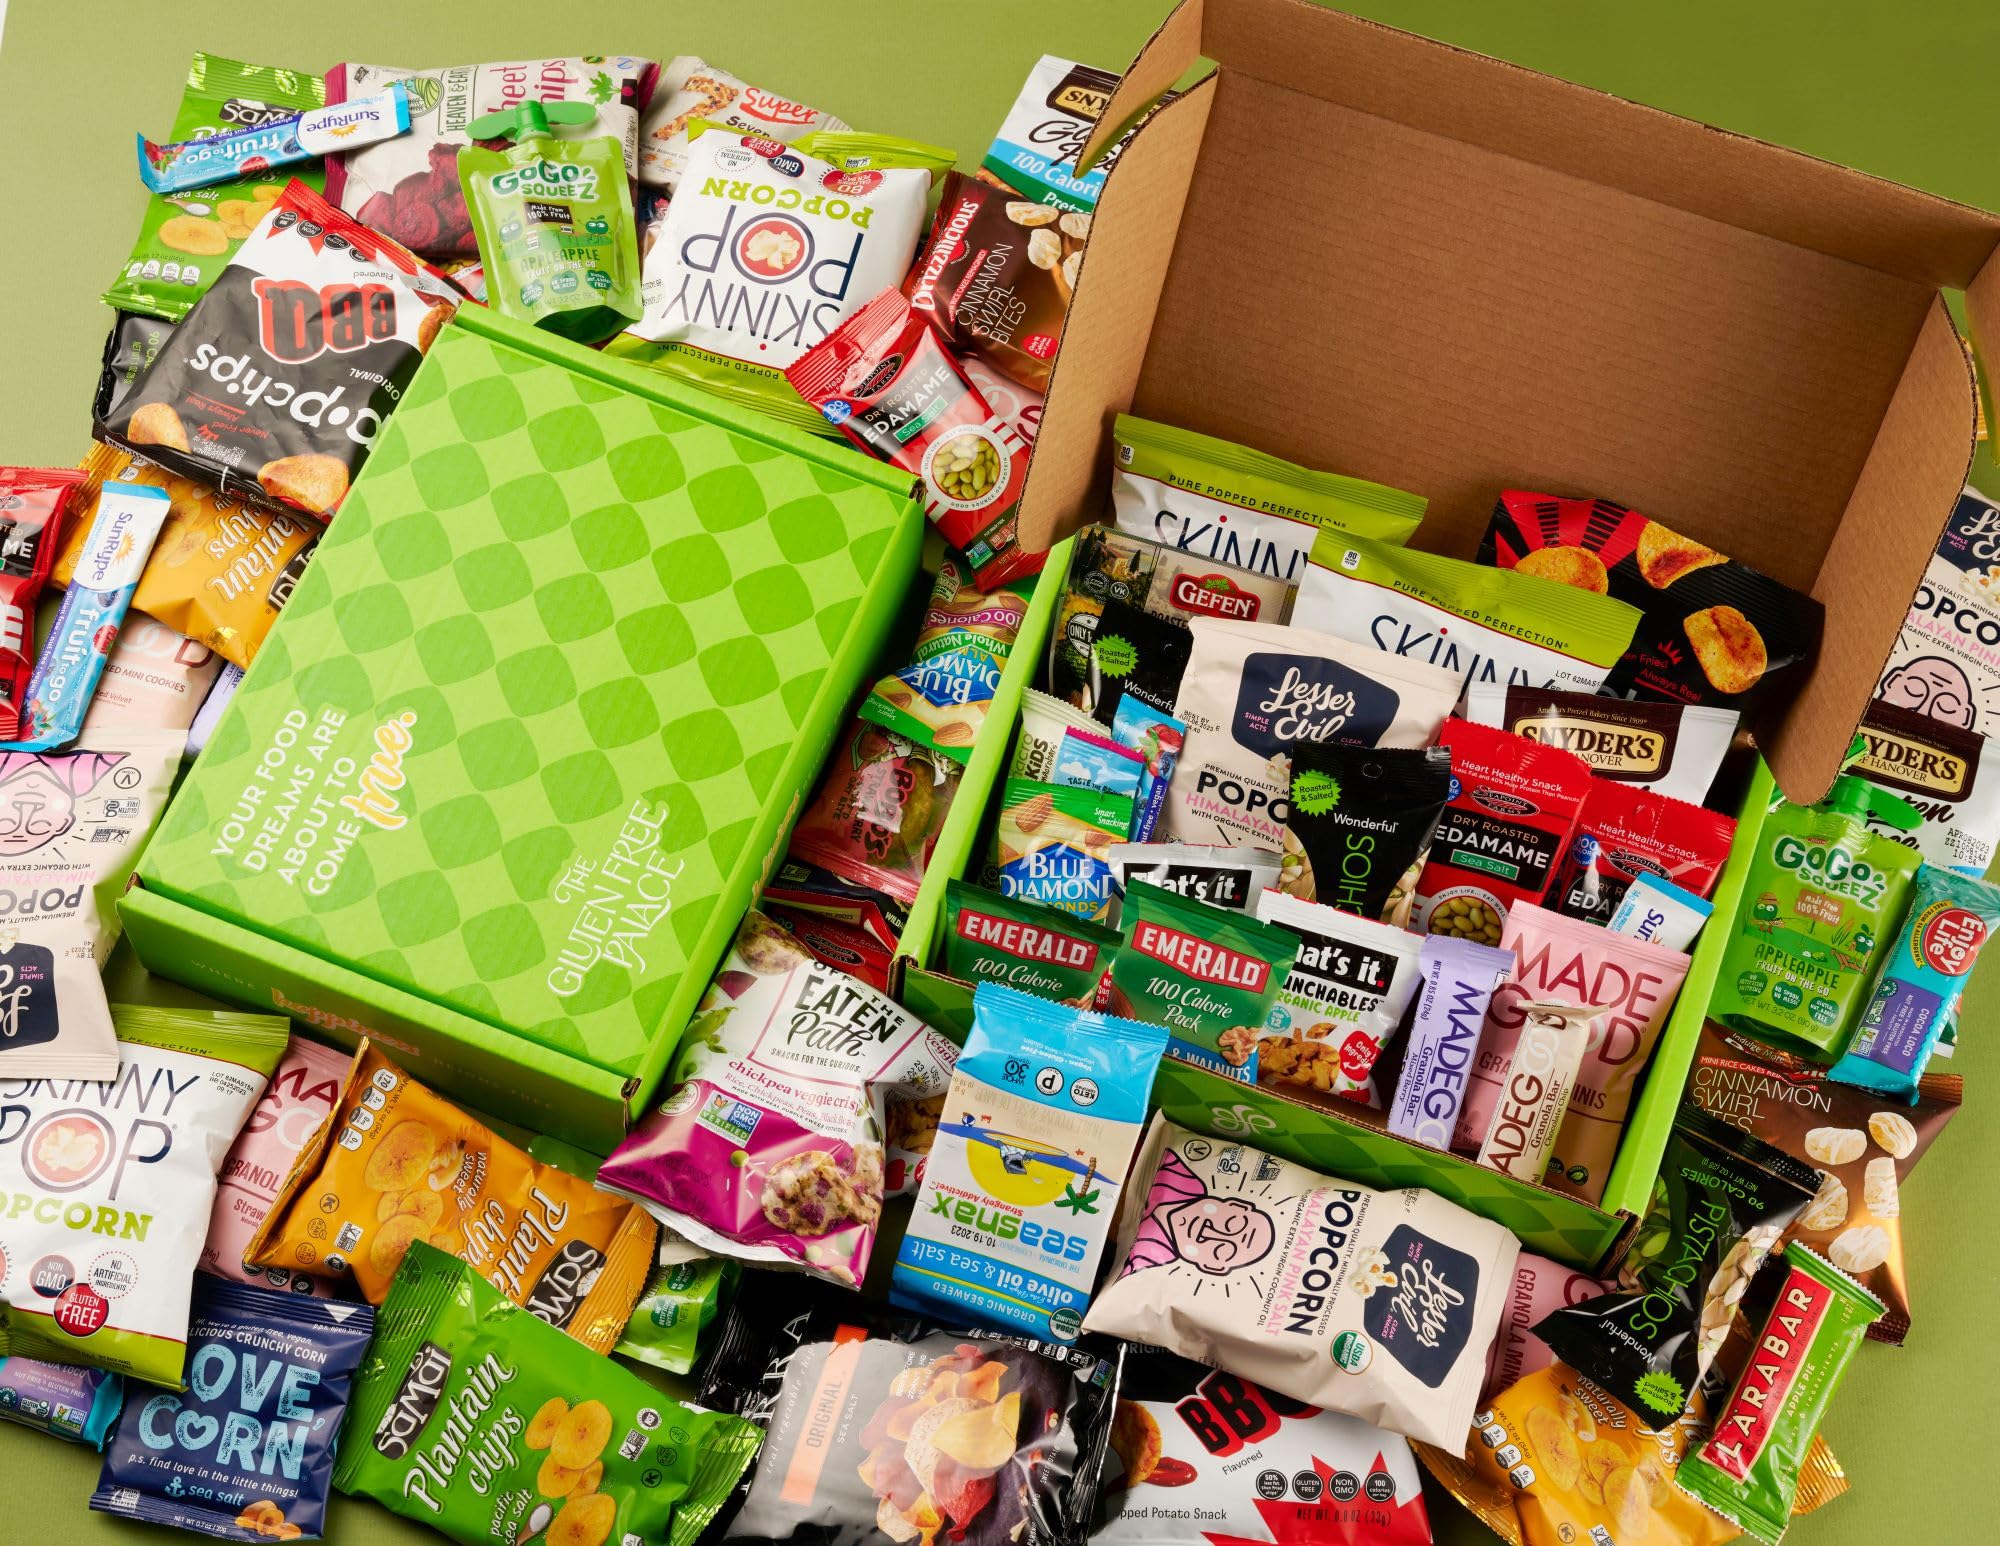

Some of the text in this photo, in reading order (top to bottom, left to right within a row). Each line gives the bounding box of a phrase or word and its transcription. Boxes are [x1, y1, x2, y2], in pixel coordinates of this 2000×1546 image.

[307, 111, 380, 132] SunRype
[446, 91, 466, 132] HEAVEN
[743, 87, 819, 121] Super
[185, 148, 211, 165] go
[227, 133, 280, 161] fruit
[1011, 152, 1101, 197] 100 Calori
[700, 177, 874, 229] POPCORN
[681, 204, 864, 301] POP
[353, 271, 394, 280] Flavored
[956, 243, 1014, 326] CINNAMON
[972, 285, 1014, 335] SWIRL
[990, 296, 1026, 344] BITES
[734, 363, 780, 380] POPPED
[862, 366, 951, 444] EDAMAME
[865, 369, 928, 422] DRY ROASTED
[1169, 474, 1201, 491] PURE
[1207, 486, 1256, 507] POPPED
[92, 512, 132, 580] SunRype
[1178, 581, 1250, 618] GEFEN
[63, 608, 96, 666] fruit
[930, 610, 1020, 628] 100 Calories
[916, 634, 1006, 659] Whole Natural
[49, 674, 66, 702] go
[122, 668, 186, 692] MINI COOKIES
[911, 666, 971, 703] BLUE
[1259, 666, 1356, 716] Lesser
[1249, 722, 1267, 732] ACTS
[1274, 700, 1345, 742] Evil
[1522, 727, 1655, 759] SNYDER'S
[211, 710, 307, 855] YOUR FOOD
[1461, 760, 1490, 774] Heart
[1492, 766, 1530, 786] Healthy
[1531, 778, 1562, 792] Snack
[1870, 755, 1927, 782] HANOVER
[243, 710, 346, 871] DREAMS ARE
[1299, 782, 1332, 793] Roasted
[1301, 791, 1333, 801] & Salted
[277, 757, 356, 885] ABOUT TO
[1095, 808, 1115, 818] Smart
[1185, 792, 1284, 838] HIMALAYAN
[1334, 813, 1395, 834] Wonderful
[1452, 814, 1539, 844] DRY ROASTED
[308, 820, 360, 895] COME
[1435, 826, 1549, 868] EDAMAME
[1460, 854, 1509, 875] Sea Salt
[1953, 849, 1977, 866] 10:54
[554, 856, 597, 903] THE
[1029, 853, 1092, 879] BLUE
[40, 912, 75, 921] PREMIUM
[548, 800, 667, 996] GLUTEN FREE
[602, 850, 685, 974] PALACE
[964, 916, 1087, 966] EMERALD
[1929, 918, 1955, 955] Life
[1946, 916, 1983, 974] Enjoy
[972, 958, 1063, 992] 100 Calorie
[1141, 927, 1262, 987] EMERALD
[1509, 932, 1662, 1023] MADE
[1756, 960, 1829, 996] FRUIT ON THE GO
[795, 974, 898, 1043] EATEN
[871, 994, 905, 1025] THE
[1145, 977, 1233, 1019] 100 Calorie
[1324, 1003, 1361, 1022] APPLE
[788, 1011, 873, 1057] Path
[1167, 1006, 1202, 1033] Pack
[1902, 1008, 1929, 1056] COCOA LOCO
[771, 1048, 798, 1064] SNACKS
[802, 1055, 814, 1065] FOR
[816, 1057, 827, 1066] THE
[729, 1060, 833, 1109] chickpea veggie
[1407, 1046, 1433, 1116] Granola Bar
[1695, 1066, 1832, 1114] CINNAMON
[1531, 1080, 1560, 1148] Granola Bar
[1692, 1087, 1765, 1119] SWIRL
[700, 1112, 748, 1138] VERIFIED
[979, 1195, 1024, 1216] Strangely
[1680, 1167, 1764, 1210] 90 CALORIES
[1357, 1194, 1371, 1227] PREMIUM
[951, 1226, 996, 1248] 10.19.2023
[36, 1271, 67, 1291] GMO
[47, 1262, 63, 1271] NON
[93, 1269, 132, 1284] ARTIFICIAL
[111, 1260, 122, 1269] NO
[912, 1241, 1073, 1304] olive oil & sea salt
[1284, 1189, 1362, 1336] POPCORN
[1333, 1260, 1349, 1296] MINIMALLY
[1628, 1199, 1728, 1341] PISTACHIOS
[69, 1293, 99, 1307] GLUTEN
[1277, 1263, 1301, 1301] PINK
[60, 1306, 100, 1328] FREE
[933, 1281, 1036, 1323] ORGANIC SEAWEED
[1265, 1303, 1288, 1335] SALT
[1317, 1297, 1336, 1335] PROCESSED
[1508, 1268, 1536, 1344] GRANOLA
[236, 1332, 327, 1363] CRUNCHY CORN
[1350, 1344, 1366, 1367] USDA
[1600, 1320, 1658, 1365] Wonderful
[1574, 1388, 1609, 1426] sweet
[1577, 1374, 1627, 1430] naturally
[1788, 1363, 1815, 1417] APPLE PIE
[402, 1352, 515, 1513] Plantain
[807, 1381, 842, 1448] ORIGINAL
[139, 1395, 310, 1480] CORN
[467, 1406, 522, 1495] chips
[128, 1454, 299, 1497] p.s. find love in the little things!
[1222, 1450, 1263, 1476] Flavored
[188, 1486, 244, 1506] sea salt
[1296, 1479, 1320, 1487] GLUTEN
[489, 1491, 514, 1537] pacific
[1152, 1507, 1227, 1520] Potato Snack
